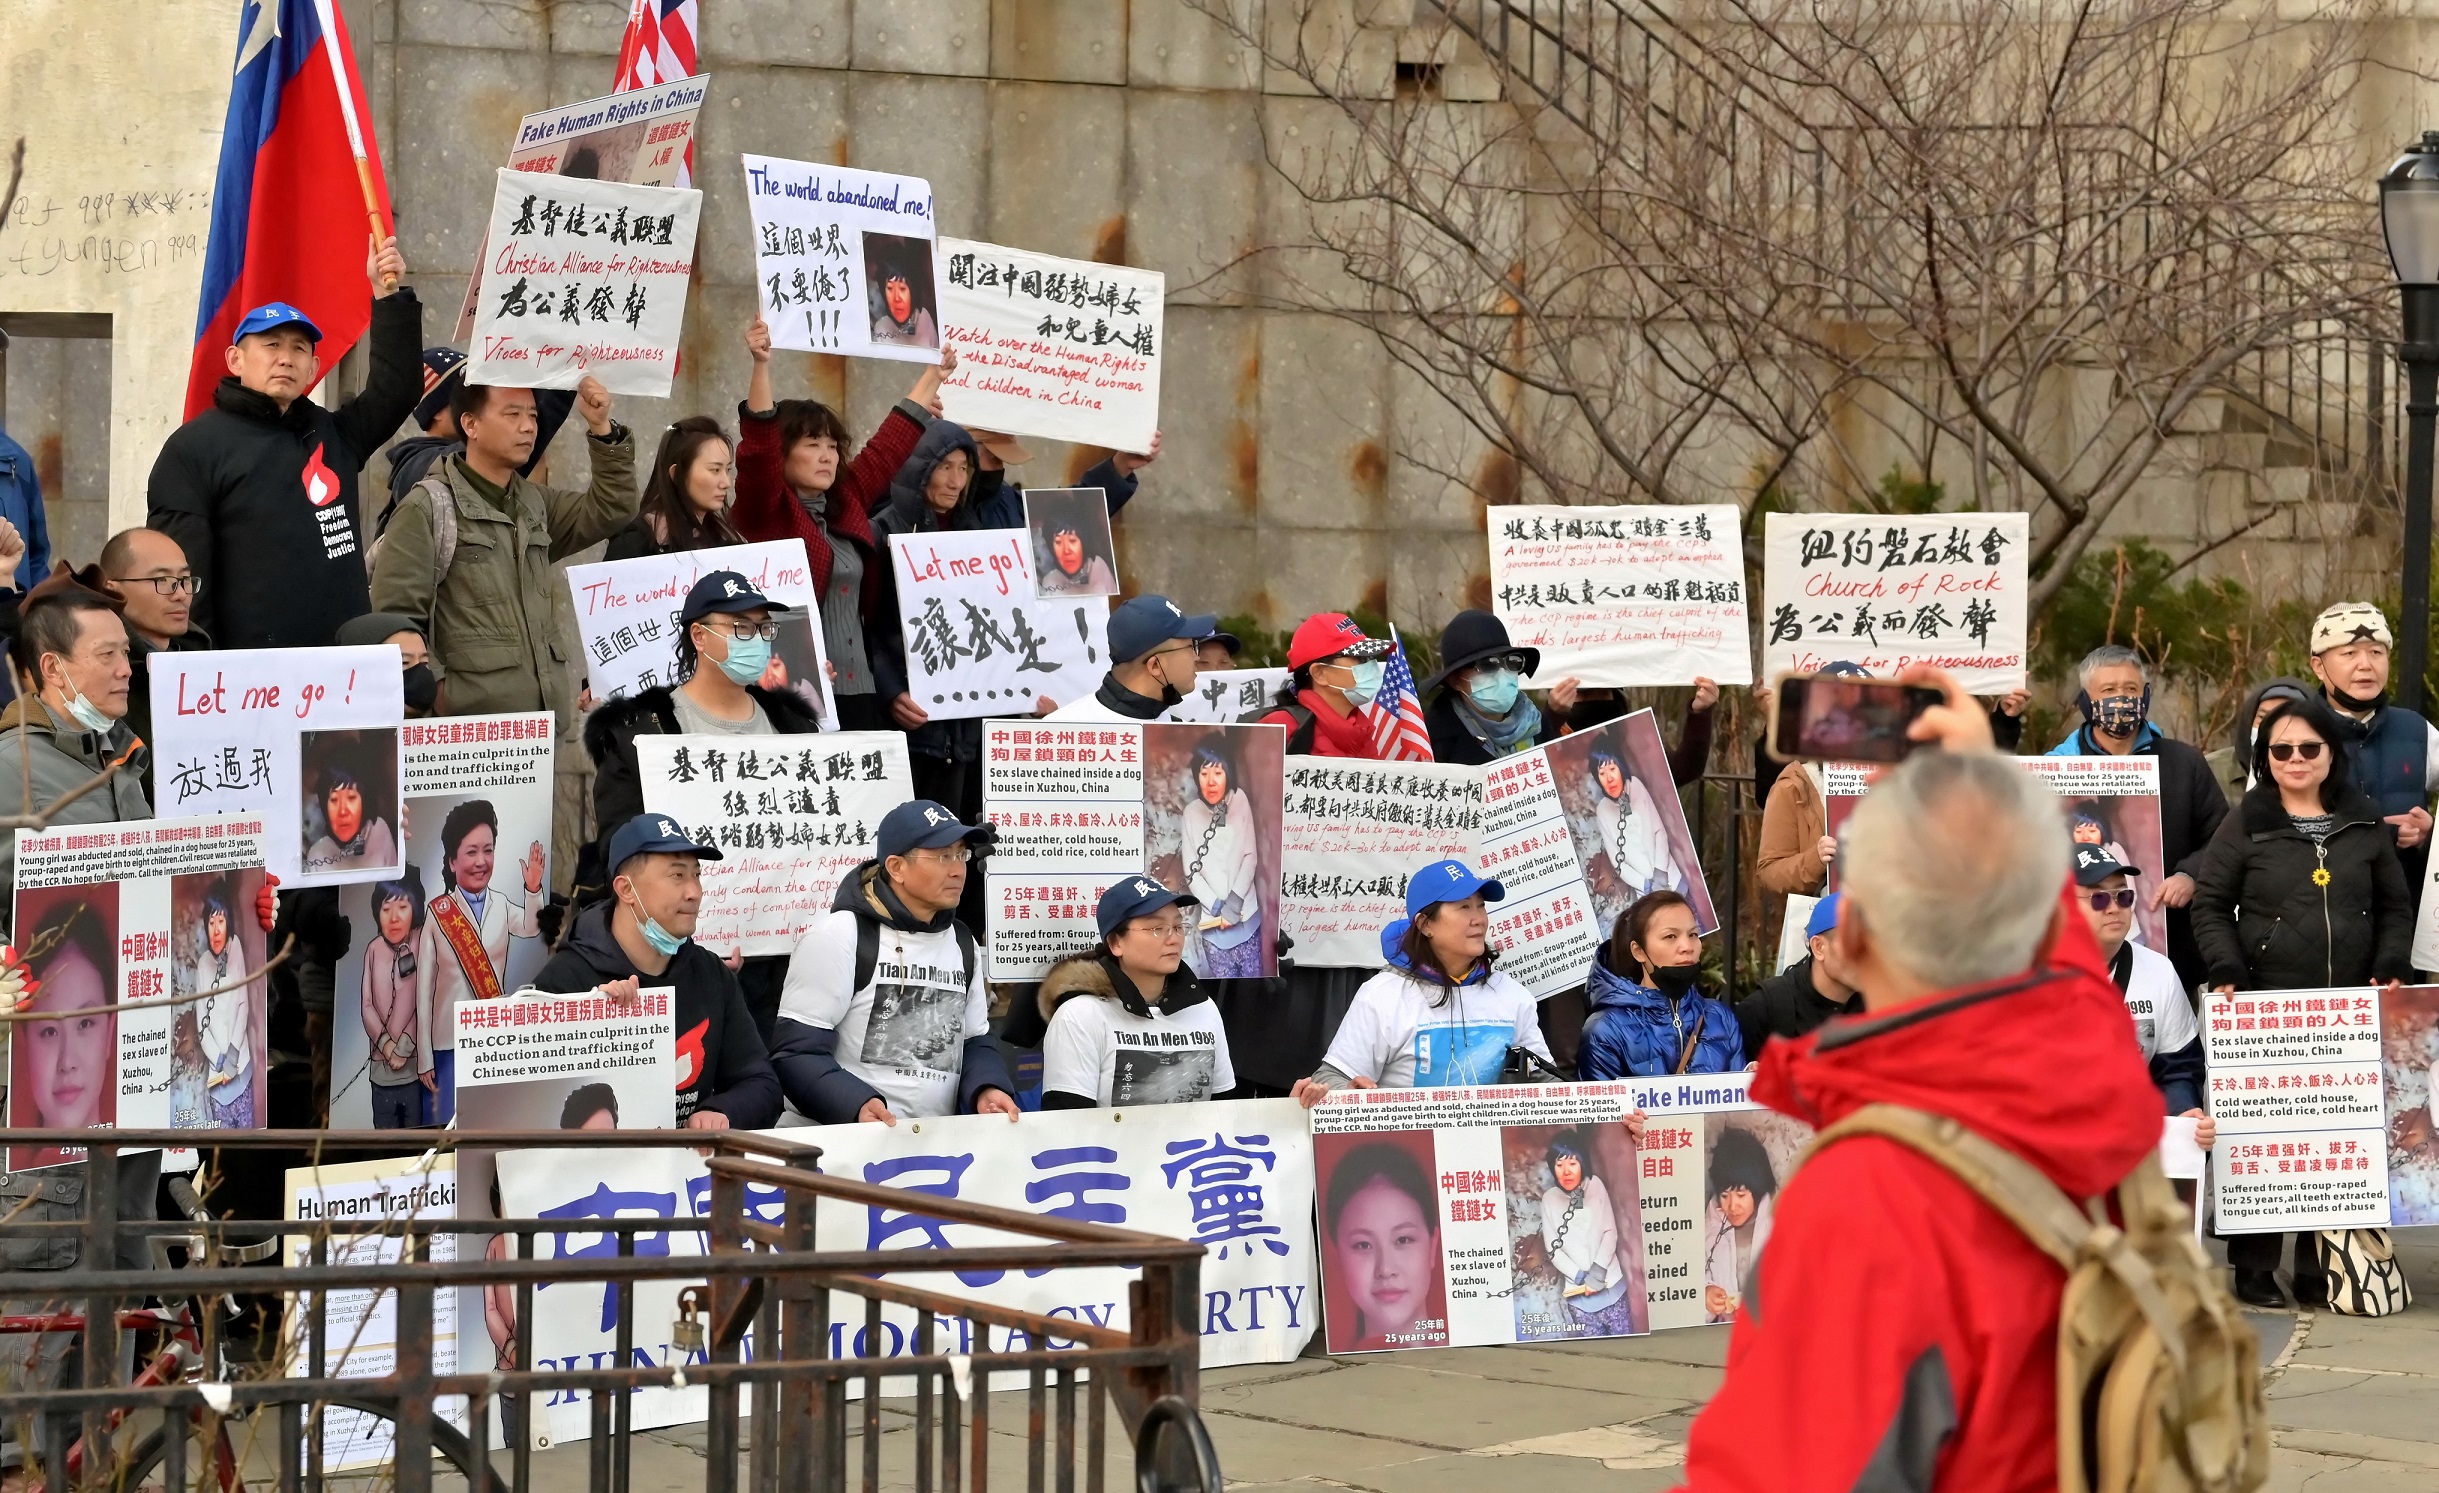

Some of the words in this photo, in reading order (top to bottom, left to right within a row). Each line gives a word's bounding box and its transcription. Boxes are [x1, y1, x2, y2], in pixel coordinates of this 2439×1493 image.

[521, 119, 553, 144] Fake
[556, 110, 604, 137] Human
[607, 98, 649, 125] Rights
[650, 94, 664, 112] in
[666, 87, 702, 108] China
[649, 148, 673, 168] 人權
[749, 164, 781, 197] The
[785, 177, 822, 202] world
[827, 179, 901, 215] abandoned
[904, 195, 932, 220] me!
[511, 195, 674, 246] 基督徒公義聯盟
[761, 222, 849, 261] 這個世界
[495, 241, 557, 275] Christian
[559, 250, 603, 276] Alliance
[604, 258, 625, 284] for
[537, 345, 564, 366] for
[998, 338, 1026, 351] over
[1030, 342, 1051, 356] the
[1055, 345, 1098, 365] Human
[1100, 353, 1146, 376] Rights
[992, 353, 1089, 386] Disadvantaged
[978, 377, 1031, 398] children
[1039, 390, 1052, 401] in
[1058, 392, 1102, 410] China
[320, 519, 350, 534] Freedom
[323, 530, 353, 547] Democracy
[327, 543, 355, 559] Justice
[901, 544, 946, 582] Let
[950, 557, 984, 577] me
[582, 577, 627, 615] The
[635, 575, 676, 603] world
[777, 567, 804, 586] me
[1805, 572, 1888, 597] Church
[1898, 573, 1929, 603] of
[1934, 571, 2003, 595] Rock
[1563, 631, 1606, 651] largest
[1612, 627, 1657, 641] human
[1660, 627, 1722, 648] trafficking
[178, 672, 226, 715] Let
[242, 686, 280, 709] me
[991, 731, 1137, 745] 中國徐州鐵鏈女
[991, 748, 1138, 762] 狗屋鎖頸的人生
[451, 762, 520, 775] trafficking
[668, 746, 888, 784] 基督徒公義聯盟
[1011, 767, 1038, 778] slave
[1041, 768, 1081, 779] chained
[1083, 768, 1113, 779] inside
[170, 747, 272, 805] 放過我
[413, 781, 456, 791] women
[1082, 783, 1110, 793] China
[2134, 788, 2158, 797] help!
[1322, 823, 1351, 840] family
[738, 858, 784, 874] Alliance
[790, 858, 812, 874] for
[1555, 858, 1575, 874] heart
[2078, 848, 2116, 868] 民主
[733, 878, 782, 896] condemn
[785, 882, 806, 893] the
[1298, 920, 1338, 942] largest
[122, 931, 168, 963] 中國徐州
[879, 962, 908, 979] Tian
[910, 964, 926, 980] An
[929, 966, 949, 984] Men
[128, 971, 163, 999] 鐵鏈女
[2212, 998, 2372, 1016] 中國徐州鐵鏈女
[2212, 1014, 2374, 1031] 狗屋鎖頸的人生
[138, 1029, 165, 1042] chained
[460, 1038, 483, 1050] The
[486, 1035, 516, 1047] CCP
[518, 1034, 529, 1044] is
[532, 1032, 552, 1043] the
[555, 1030, 587, 1041] main
[590, 1027, 633, 1042] culprit
[635, 1025, 647, 1034] in
[650, 1024, 669, 1034] the
[1114, 1031, 1140, 1046] Tian
[1143, 1032, 1158, 1046] An
[1161, 1032, 1189, 1047] Men
[1190, 1031, 1215, 1045] 1989
[2212, 1037, 2232, 1047] Sex
[2234, 1035, 2263, 1045] slave
[2266, 1033, 2310, 1044] chained
[2313, 1033, 2346, 1042] inside
[2349, 1033, 2355, 1041] a
[2358, 1031, 2378, 1042] dog
[475, 1049, 540, 1063] abduction
[542, 1046, 566, 1058] and
[568, 1042, 639, 1057] trafficking
[642, 1040, 654, 1050] of
[2213, 1050, 2246, 1059] house
[2250, 1049, 2259, 1058] in
[2262, 1048, 2309, 1058] Xuzhou,
[2312, 1046, 2342, 1056] China
[473, 1066, 526, 1079] Chinese
[528, 1064, 574, 1074] women
[577, 1060, 600, 1070] and
[603, 1056, 656, 1068] children
[122, 1083, 142, 1095] China
[1678, 1086, 1745, 1106] Human
[2216, 1099, 2240, 1107] Cold
[2243, 1097, 2292, 1107] weather,
[2295, 1095, 2318, 1104] cold
[2321, 1094, 2357, 1103] house,
[1314, 1108, 1342, 1116] Young
[1643, 1156, 1674, 1178] 自由
[1441, 1170, 1501, 1194] 中國徐州
[2222, 1184, 2265, 1194] Suffered
[2268, 1183, 2297, 1191] from:
[2300, 1180, 2367, 1191] Group-raped
[298, 1193, 370, 1220] Human
[1451, 1199, 1496, 1222] 鐵鏈女
[2223, 1207, 2260, 1217] tongue
[2263, 1207, 2282, 1215] cut,
[2301, 1205, 2329, 1213] kinds
[2344, 1203, 2375, 1211] abuse
[1449, 1249, 1464, 1259] The
[1467, 1247, 1503, 1258] chained
[1649, 1242, 1671, 1256] the
[1450, 1261, 1466, 1271] sex
[1470, 1260, 1495, 1270] slave
[1497, 1259, 1507, 1269] of
[1452, 1276, 1489, 1287] Xuzhou,
[1452, 1289, 1477, 1299] China
[1659, 1286, 1697, 1302] slave
[1414, 1319, 1444, 1330] 25年前
[1521, 1313, 1550, 1324] 25年後
[1521, 1324, 1533, 1334] 25
[1535, 1324, 1560, 1335] years
[1562, 1322, 1585, 1332] later
[1385, 1333, 1396, 1343] 25
[1398, 1333, 1427, 1344] years
[1428, 1332, 1446, 1343] ago
